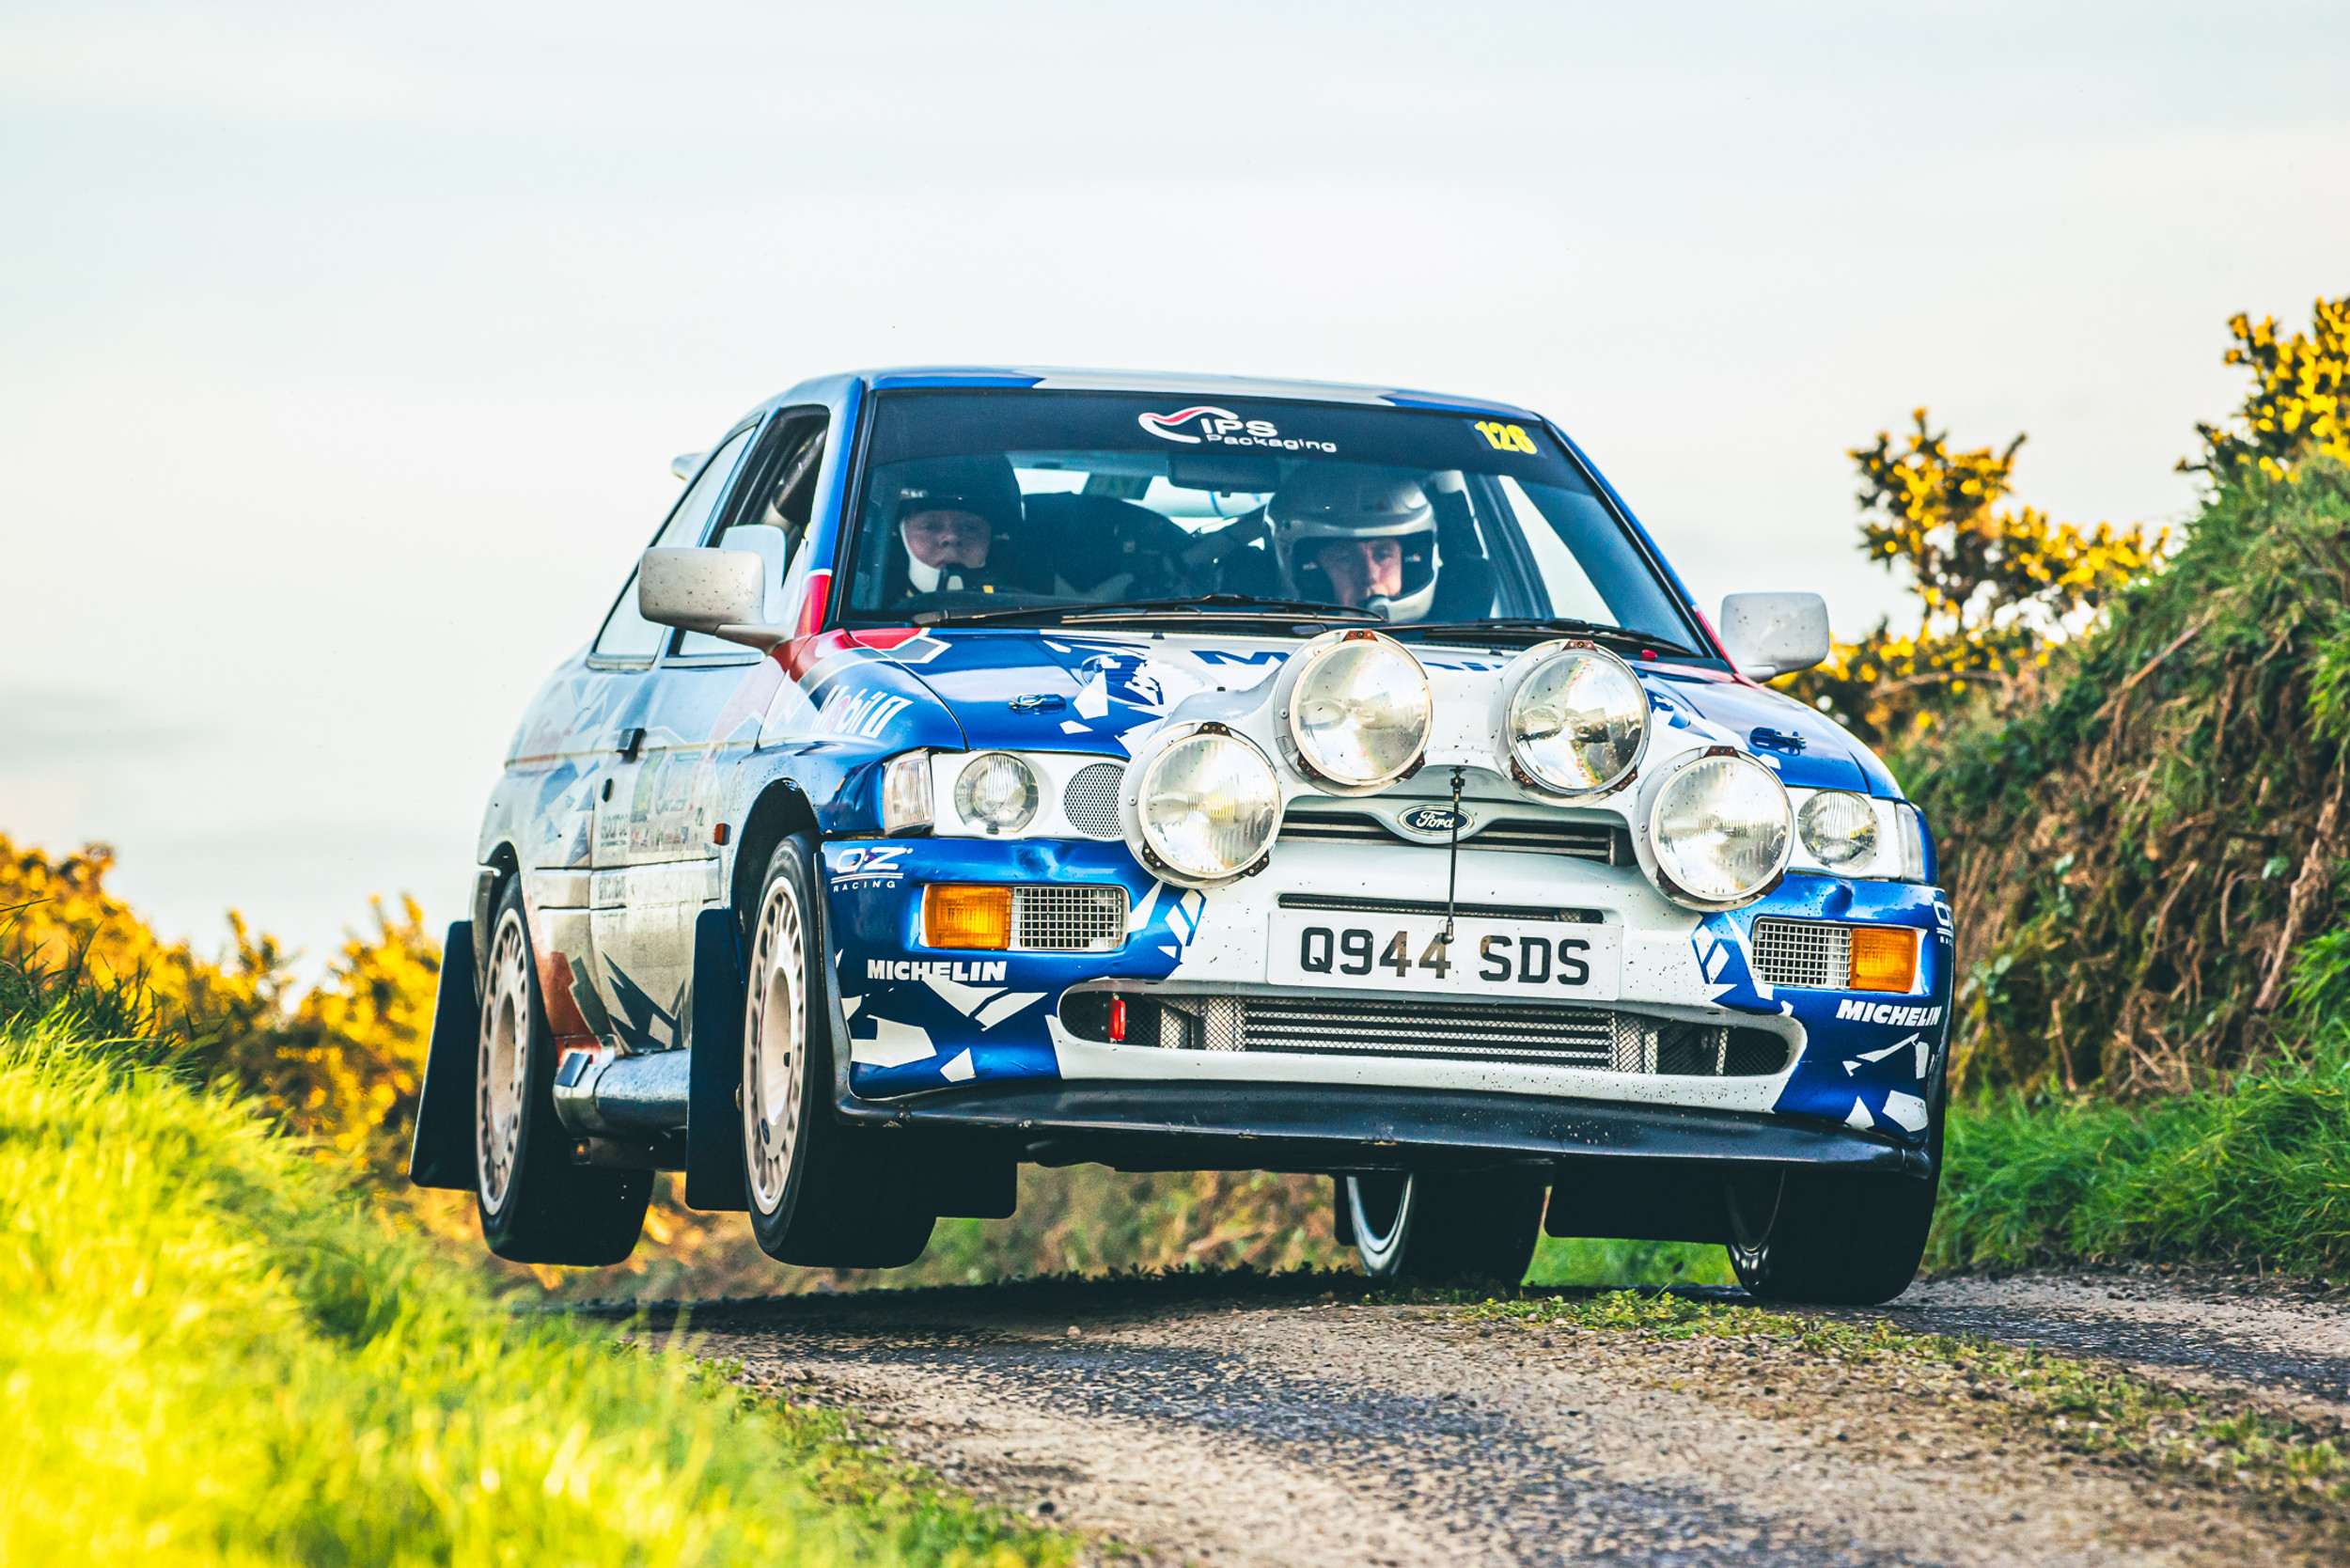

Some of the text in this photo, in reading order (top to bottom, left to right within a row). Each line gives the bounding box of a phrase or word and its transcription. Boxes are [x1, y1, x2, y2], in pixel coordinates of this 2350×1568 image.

[1199, 417, 1278, 438] IPS
[1474, 420, 1539, 455] 126
[1206, 433, 1338, 453] Packaging
[1416, 810, 1455, 828] Ford
[836, 847, 905, 873] OZ
[833, 880, 897, 892] RACING
[1301, 926, 1591, 986] Q944 SDS
[867, 959, 1008, 982] MICHELIN
[1836, 998, 1943, 1027] MICHELIN
